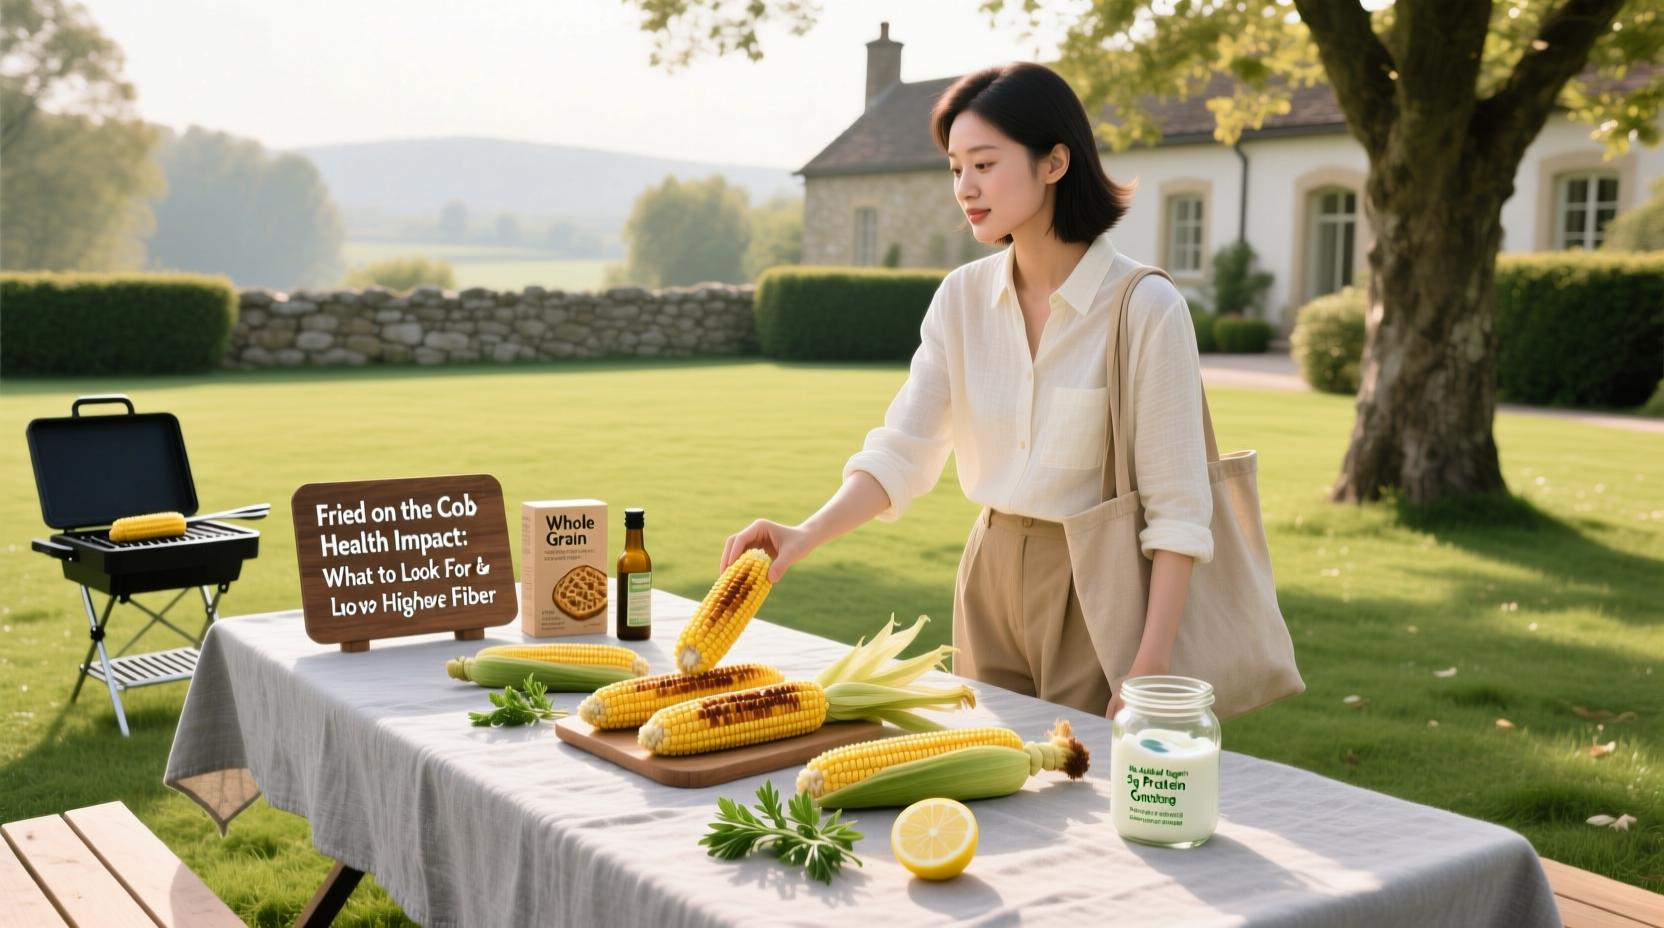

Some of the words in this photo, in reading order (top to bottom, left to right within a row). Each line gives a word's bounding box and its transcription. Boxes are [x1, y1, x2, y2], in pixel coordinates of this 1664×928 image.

[316, 500, 366, 527] Fried
[371, 507, 396, 522] on
[401, 498, 433, 521] the
[437, 493, 477, 518] Cob
[546, 514, 595, 531] Whole
[320, 530, 389, 557] Health
[394, 527, 468, 556] Impact:
[546, 531, 587, 546] Grain
[322, 565, 374, 588] What
[378, 566, 396, 583] to
[400, 558, 440, 582] Look
[444, 558, 472, 578] For
[451, 586, 496, 607] Fiber
